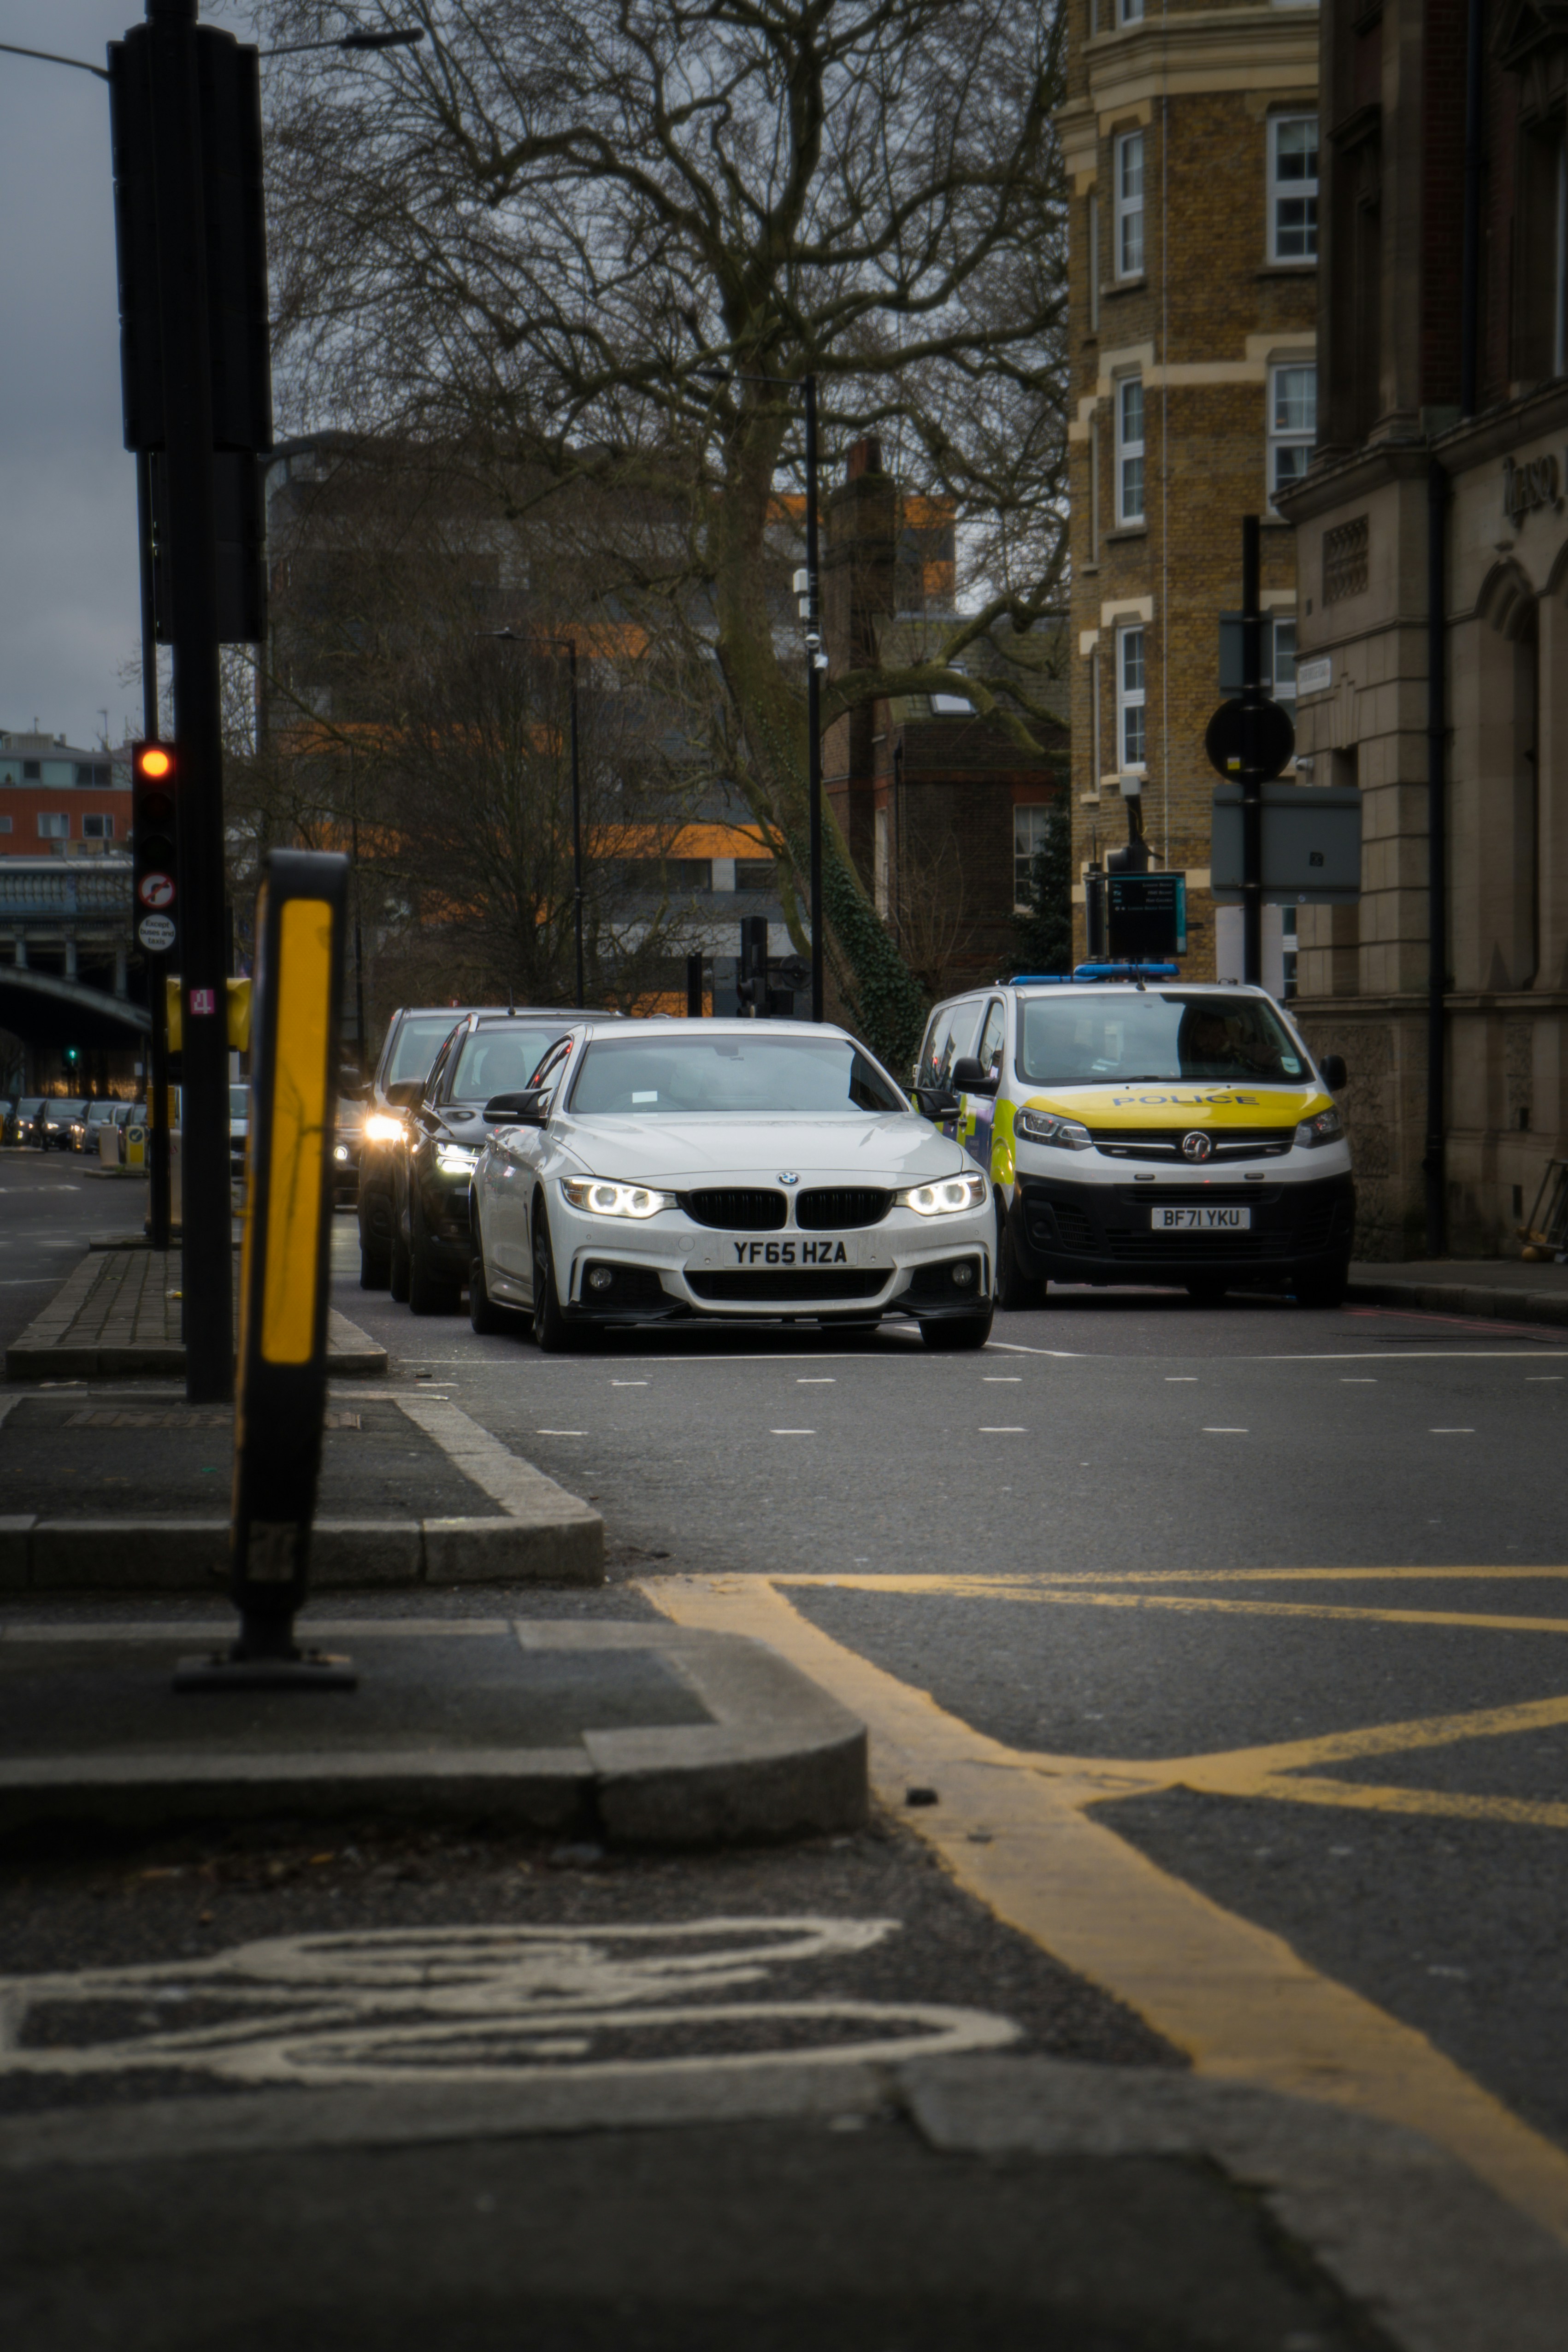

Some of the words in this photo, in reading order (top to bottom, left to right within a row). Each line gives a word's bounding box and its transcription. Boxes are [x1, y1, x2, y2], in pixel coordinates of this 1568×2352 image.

[146, 919, 170, 928] Except
[194, 990, 211, 1014] 4
[1113, 1095, 1260, 1106] POLICE
[1164, 1210, 1201, 1226] BF71
[1207, 1210, 1239, 1226] YKU
[734, 1242, 795, 1263] YF65
[803, 1241, 847, 1263] HZA
